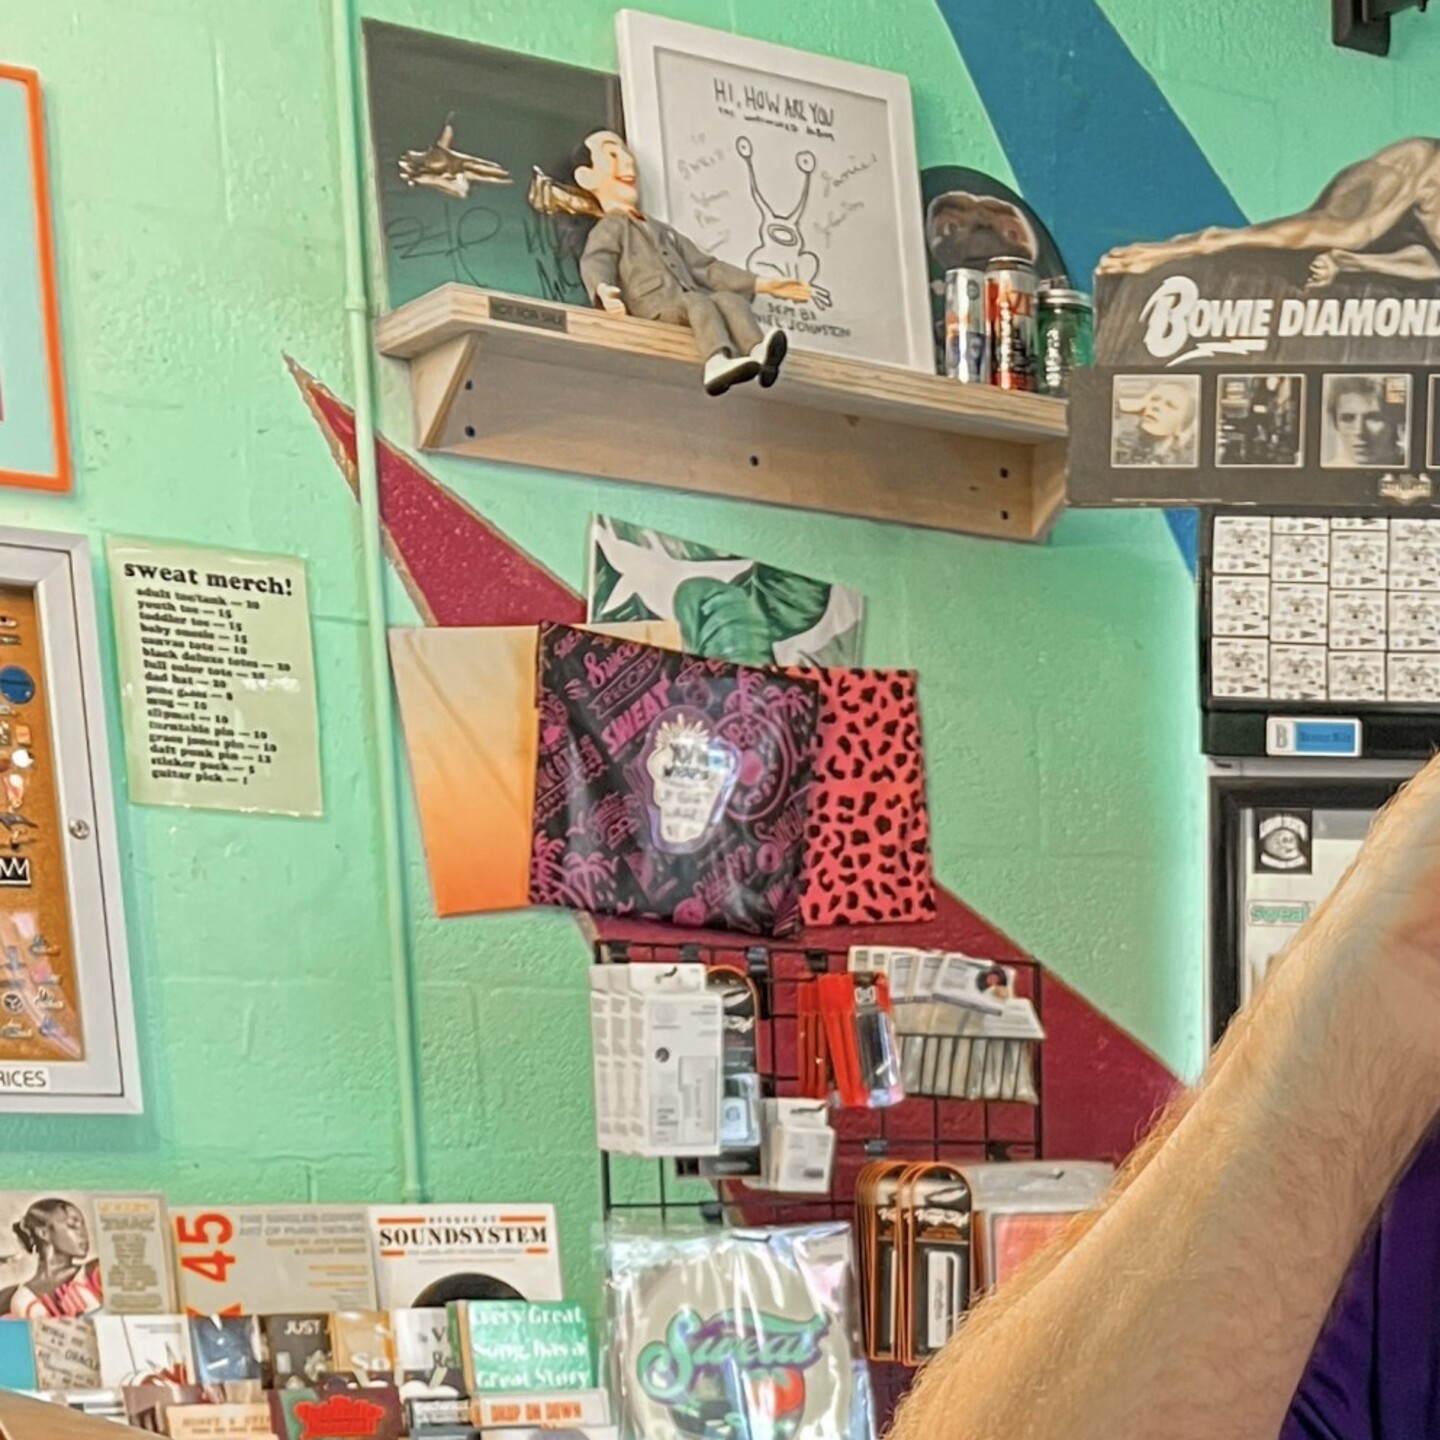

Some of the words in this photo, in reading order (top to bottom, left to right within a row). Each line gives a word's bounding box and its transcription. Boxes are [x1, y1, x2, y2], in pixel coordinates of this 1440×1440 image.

[744, 86, 779, 114] HOW
[809, 103, 833, 126] YOU
[124, 562, 198, 584] sweat
[206, 572, 292, 596] merch!
[136, 587, 171, 599] adult
[138, 600, 176, 612] youth
[219, 608, 232, 618] 15
[139, 611, 186, 624] toddler
[140, 622, 170, 636] baby
[235, 634, 248, 644] 15
[142, 646, 178, 659] black
[145, 671, 168, 681] dad
[172, 673, 193, 684] hat
[147, 697, 174, 708] mug
[601, 668, 671, 757] SWEAT
[150, 744, 176, 754] daft
[180, 747, 214, 758] punk
[151, 756, 196, 768] sticker
[379, 1226, 547, 1247] SOUNDSYSTEM
[176, 1212, 236, 1283] 45
[528, 1304, 581, 1324] Great
[284, 1319, 322, 1336] JUST
